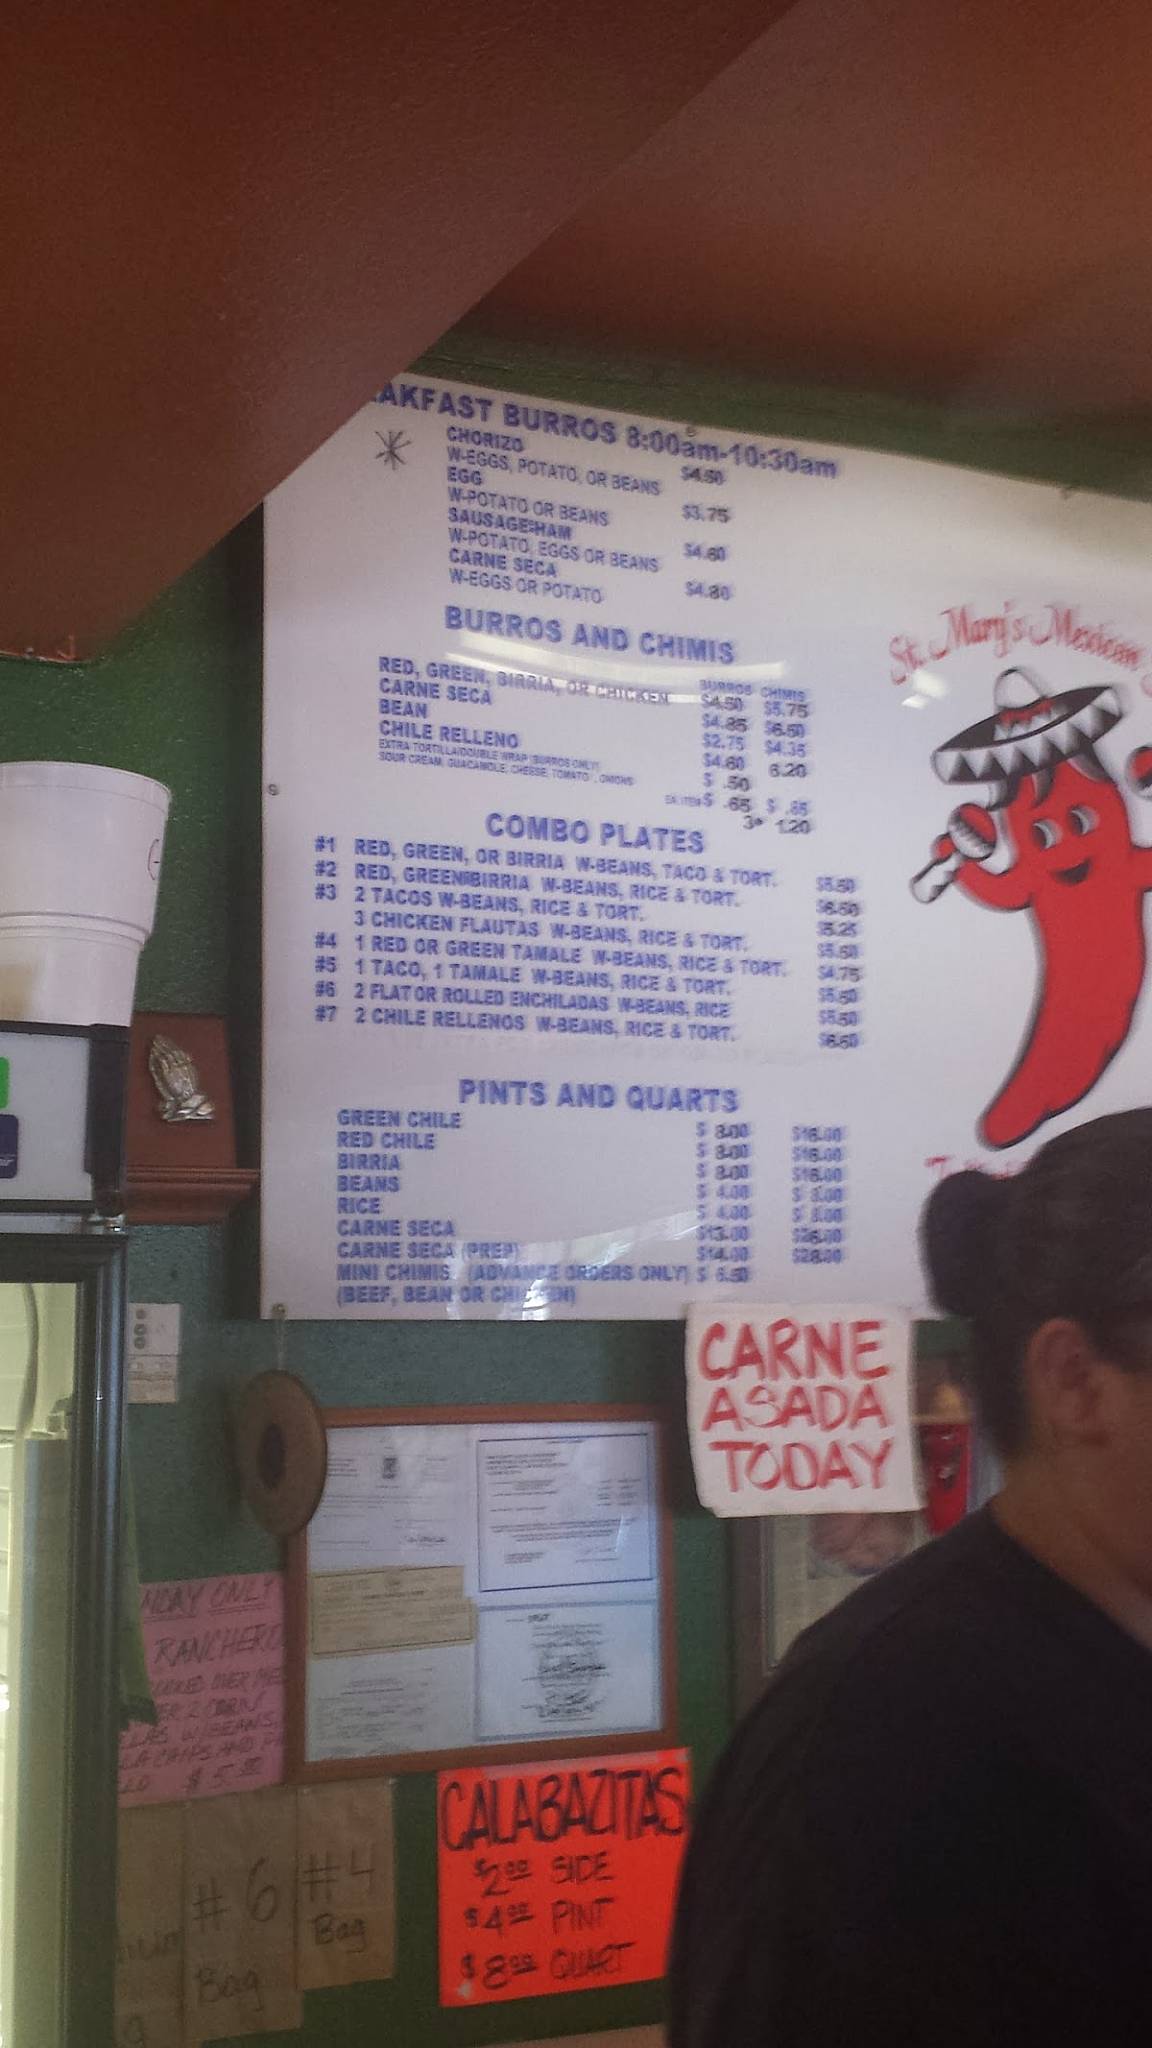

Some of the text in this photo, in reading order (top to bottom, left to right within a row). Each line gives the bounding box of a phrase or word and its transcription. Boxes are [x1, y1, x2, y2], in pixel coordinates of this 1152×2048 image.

[373, 383, 838, 479] AKFAST BURROS 8:00am-10:30am
[447, 426, 525, 453] CHORIZO
[447, 466, 731, 523] EGG $3.75
[586, 470, 608, 488] OR
[612, 474, 661, 496] BEANS
[448, 487, 610, 527] W-POTATO OR BEANS
[449, 548, 507, 571] CARNE
[513, 557, 557, 578] SECA
[539, 541, 580, 562] EGGS
[585, 549, 605, 566] OR
[611, 551, 660, 573] BEANS
[449, 568, 602, 604] W-EGGS OR POTATO
[445, 605, 735, 665] BURROS AND CHIMIS
[379, 656, 420, 680] RED,
[426, 662, 490, 688] GREEN,
[567, 680, 589, 697] OR
[764, 700, 809, 719] $5.75
[379, 677, 440, 700] CARNE
[446, 685, 492, 706] SECA
[379, 698, 745, 751] BEAN $2.75
[379, 720, 432, 740] CHILE
[440, 726, 519, 749] RELLENO
[486, 813, 705, 854] COMBO PLATES
[315, 836, 335, 852] #1
[355, 838, 396, 861] RED,
[403, 843, 470, 866] GREEN,
[476, 849, 500, 866] OR
[506, 851, 564, 871] BIRRIA
[662, 863, 706, 881] TACO
[315, 861, 336, 877] #2
[355, 863, 396, 885] RED,
[630, 884, 668, 902] RICE
[315, 884, 336, 901] #3
[355, 886, 364, 903] 2
[371, 887, 432, 907] TACOS
[531, 899, 570, 917] RICE
[354, 910, 364, 926] 3
[371, 911, 453, 932] CHICKEN
[460, 917, 539, 938] FLAUTAS
[639, 929, 676, 947] RICE
[315, 932, 336, 948] #4
[355, 934, 364, 951] 1
[371, 935, 407, 953] RED
[414, 938, 438, 955] OR
[446, 940, 505, 959] GREEN
[512, 944, 581, 964] TAMALE
[679, 955, 717, 972] RICE
[315, 956, 336, 973] #5
[355, 958, 364, 975] 1
[371, 959, 427, 981] TACO,
[433, 963, 443, 979] 1
[450, 963, 521, 983] TAMALE
[621, 973, 659, 991] RICE
[315, 980, 336, 998] #6
[354, 982, 364, 999] 2
[371, 983, 412, 1001] FLAT
[414, 986, 437, 1003] OR
[443, 987, 504, 1006] ROLLED
[510, 991, 609, 1012] ENCHILADAS
[695, 1001, 731, 1019] RICE
[315, 1004, 336, 1022] #7
[355, 1007, 366, 1024] 2
[371, 1007, 427, 1026] CHILE
[433, 1011, 525, 1031] RELLENOS
[626, 1020, 665, 1038] RICE
[459, 1078, 739, 1114] PINTS AND QUARTS
[337, 1109, 461, 1129] GREEN CHILE
[337, 1131, 435, 1150] RED CHILE
[337, 1153, 400, 1170] BIRRIA
[337, 1175, 400, 1192] BEANS
[337, 1197, 381, 1214] RICE
[337, 1219, 456, 1238] CARNE SECA
[337, 1242, 519, 1262] CARNE SECA (PREP)
[337, 1264, 379, 1281] MINI
[386, 1264, 449, 1281] CHIMIS
[566, 1264, 633, 1282] ORDERS
[639, 1264, 688, 1284] ONLY)
[403, 1286, 452, 1304] BEAN
[459, 1286, 484, 1304] OR
[699, 1318, 889, 1381] CARNE
[702, 1383, 892, 1432] ASADA
[709, 1436, 894, 1493] TODAY
[440, 1767, 687, 1852] CALABAZITAS
[552, 1851, 615, 1885] SIDE
[314, 1911, 368, 1954] Bag
[552, 1897, 615, 1936] PINT
[550, 1941, 637, 1981] QUART
[195, 1966, 264, 2014] Bag
